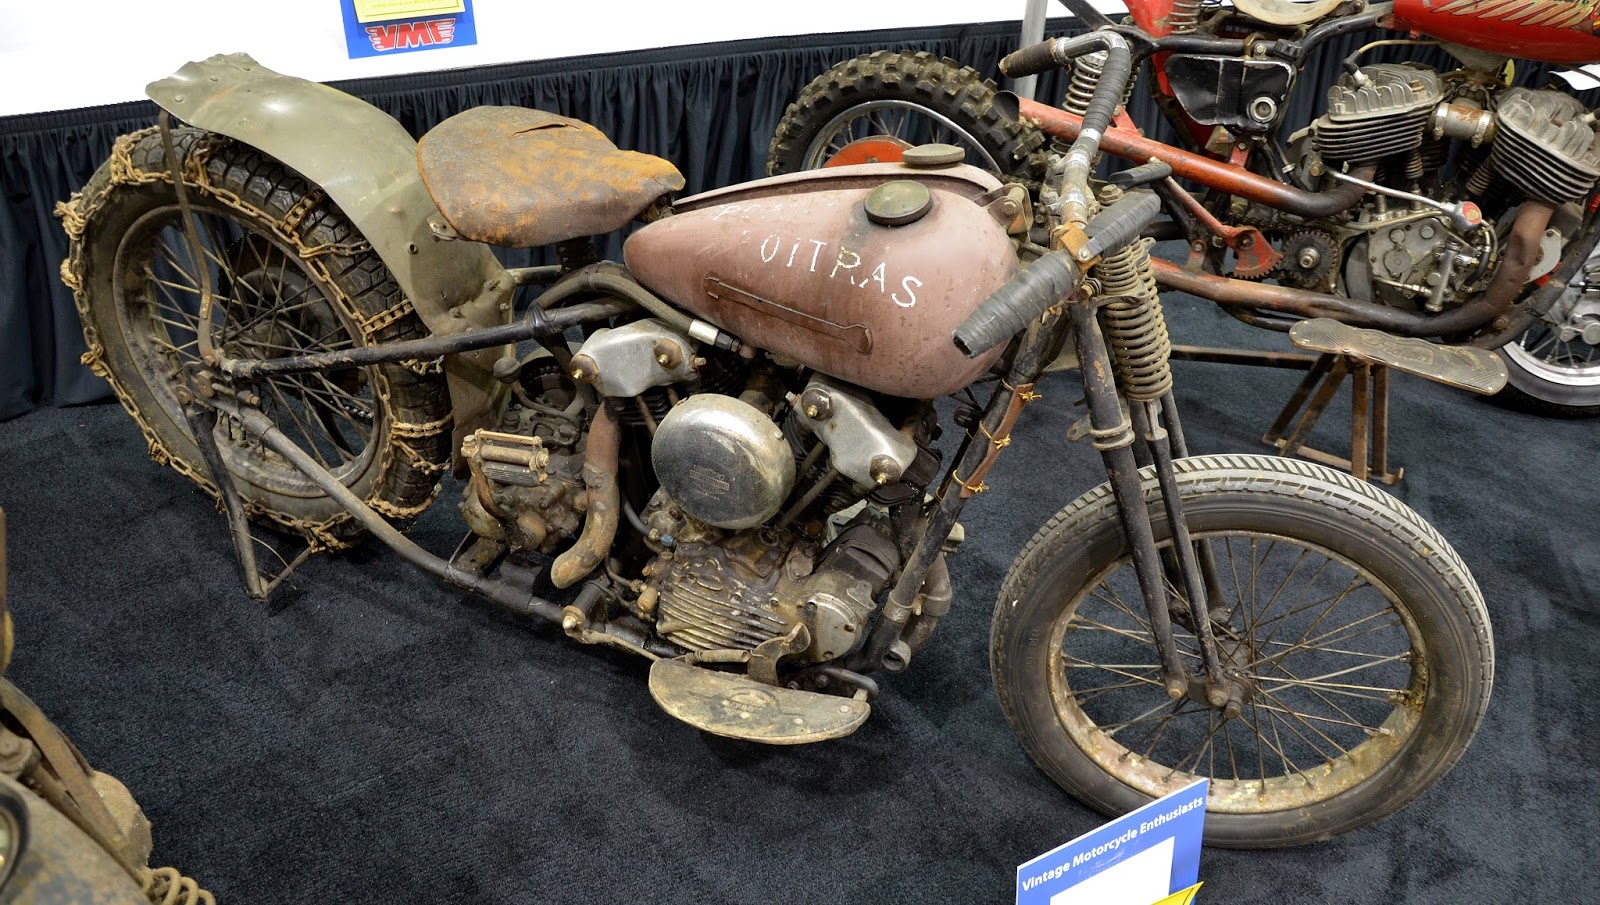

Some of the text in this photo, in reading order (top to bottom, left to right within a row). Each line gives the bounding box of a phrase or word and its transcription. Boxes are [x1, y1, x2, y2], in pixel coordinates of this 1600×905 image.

[365, 18, 456, 51] VME
[742, 229, 923, 308] OITRAS
[1022, 796, 1204, 891] Vintage Motorcycle Enthusiasts
